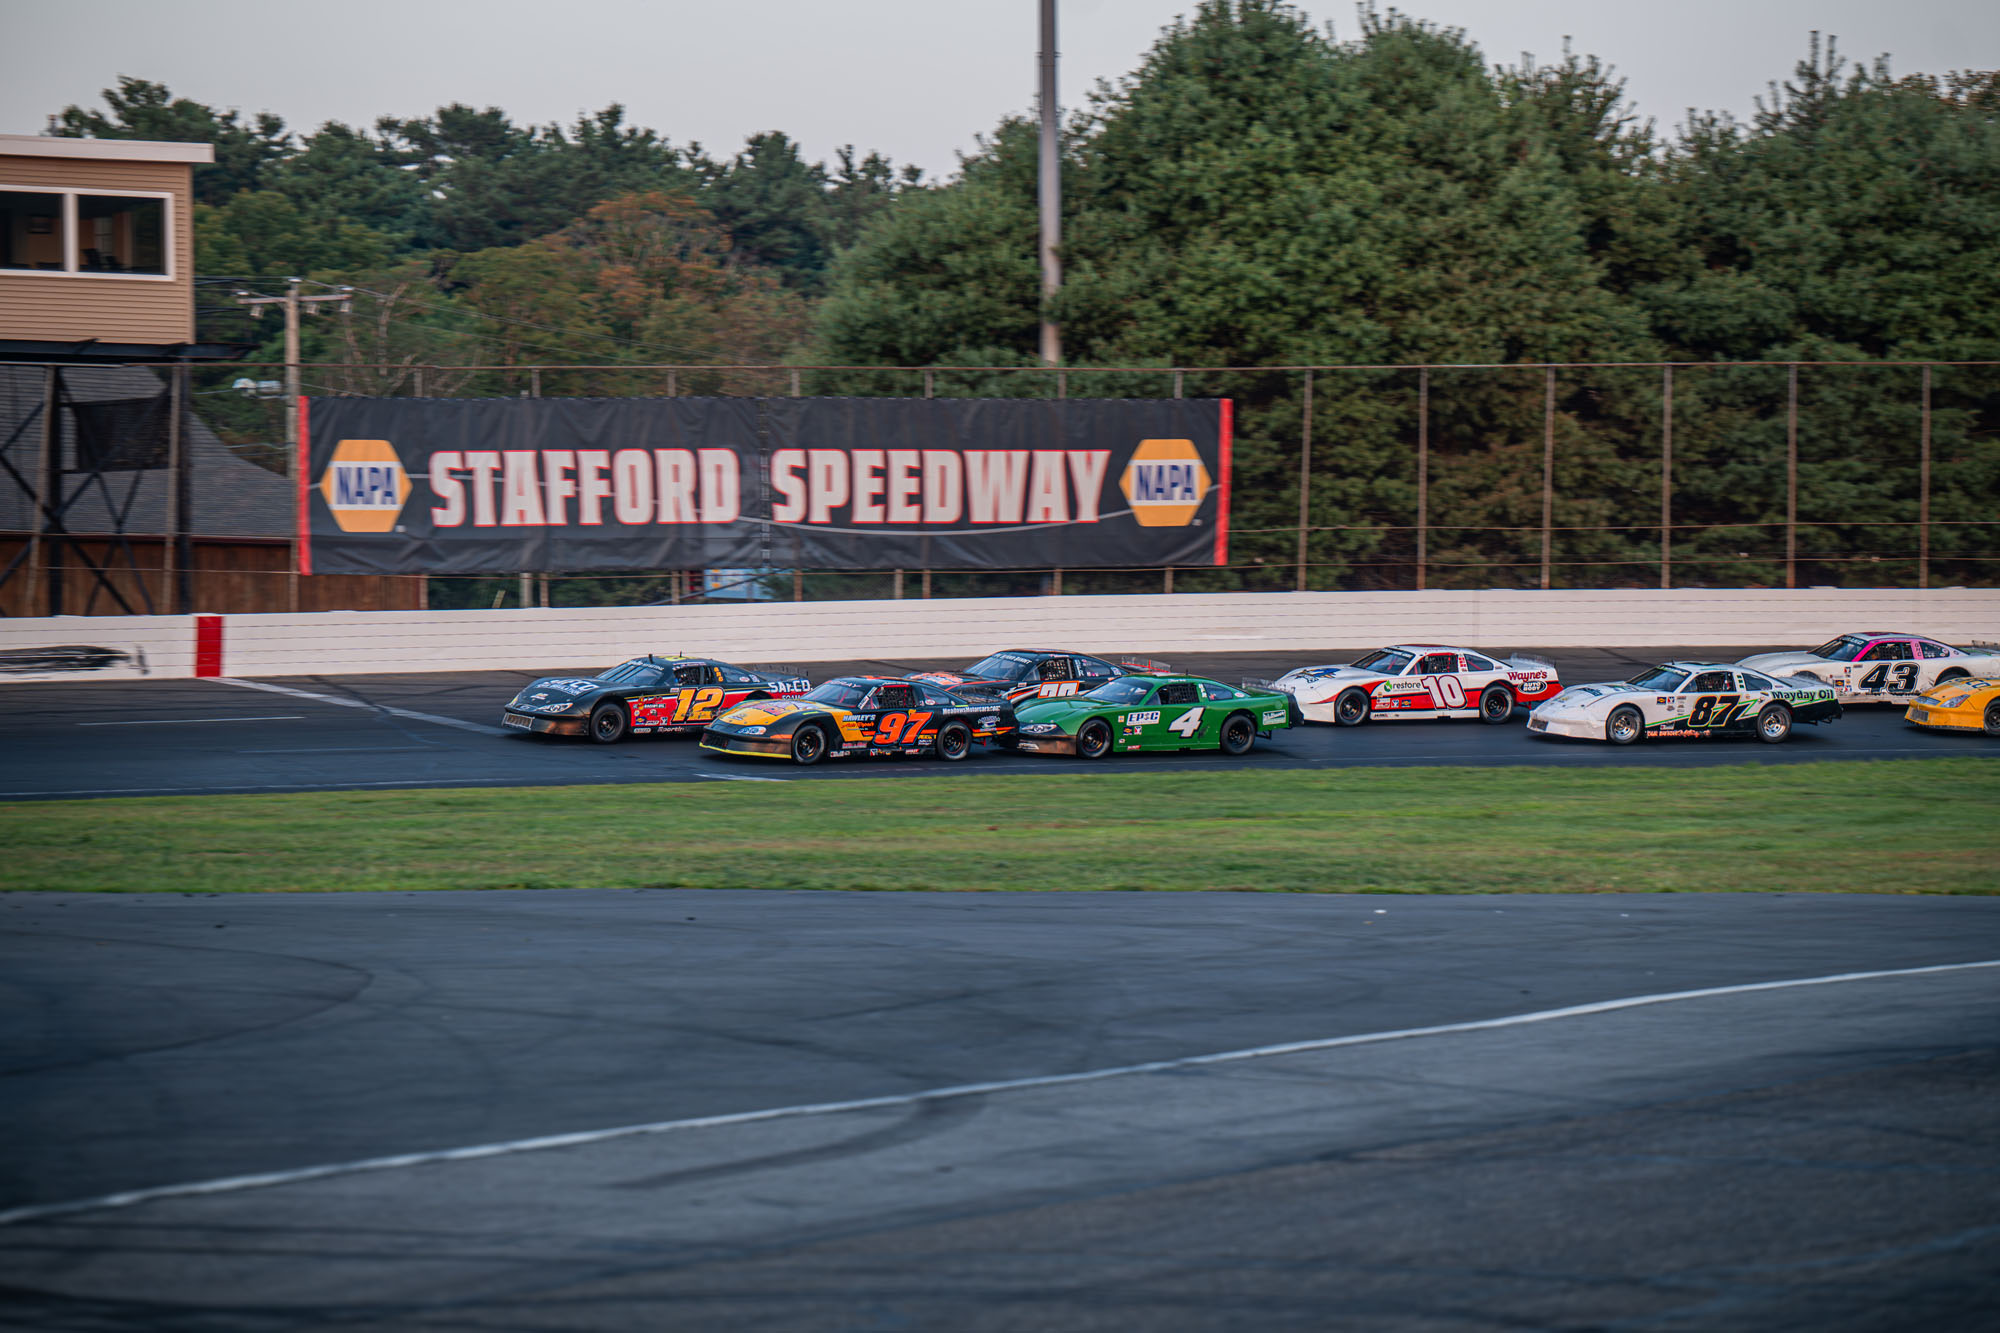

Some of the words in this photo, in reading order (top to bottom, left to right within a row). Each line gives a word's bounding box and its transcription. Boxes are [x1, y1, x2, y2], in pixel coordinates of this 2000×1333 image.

[336, 466, 398, 505] NAPA
[429, 448, 740, 527] STAFFORD
[770, 448, 1112, 524] SPEEDWAY
[1135, 463, 1198, 501] NAPA
[1393, 681, 1421, 689] restore
[1421, 674, 1467, 710] 10
[1507, 670, 1548, 682] Wayne's
[1858, 662, 1920, 695] 43
[671, 686, 725, 724] 12
[1687, 694, 1741, 727] 87
[1771, 690, 1815, 701] Mayday
[1819, 690, 1834, 699] Oil
[873, 711, 934, 746] 97
[1167, 706, 1206, 739] 4
